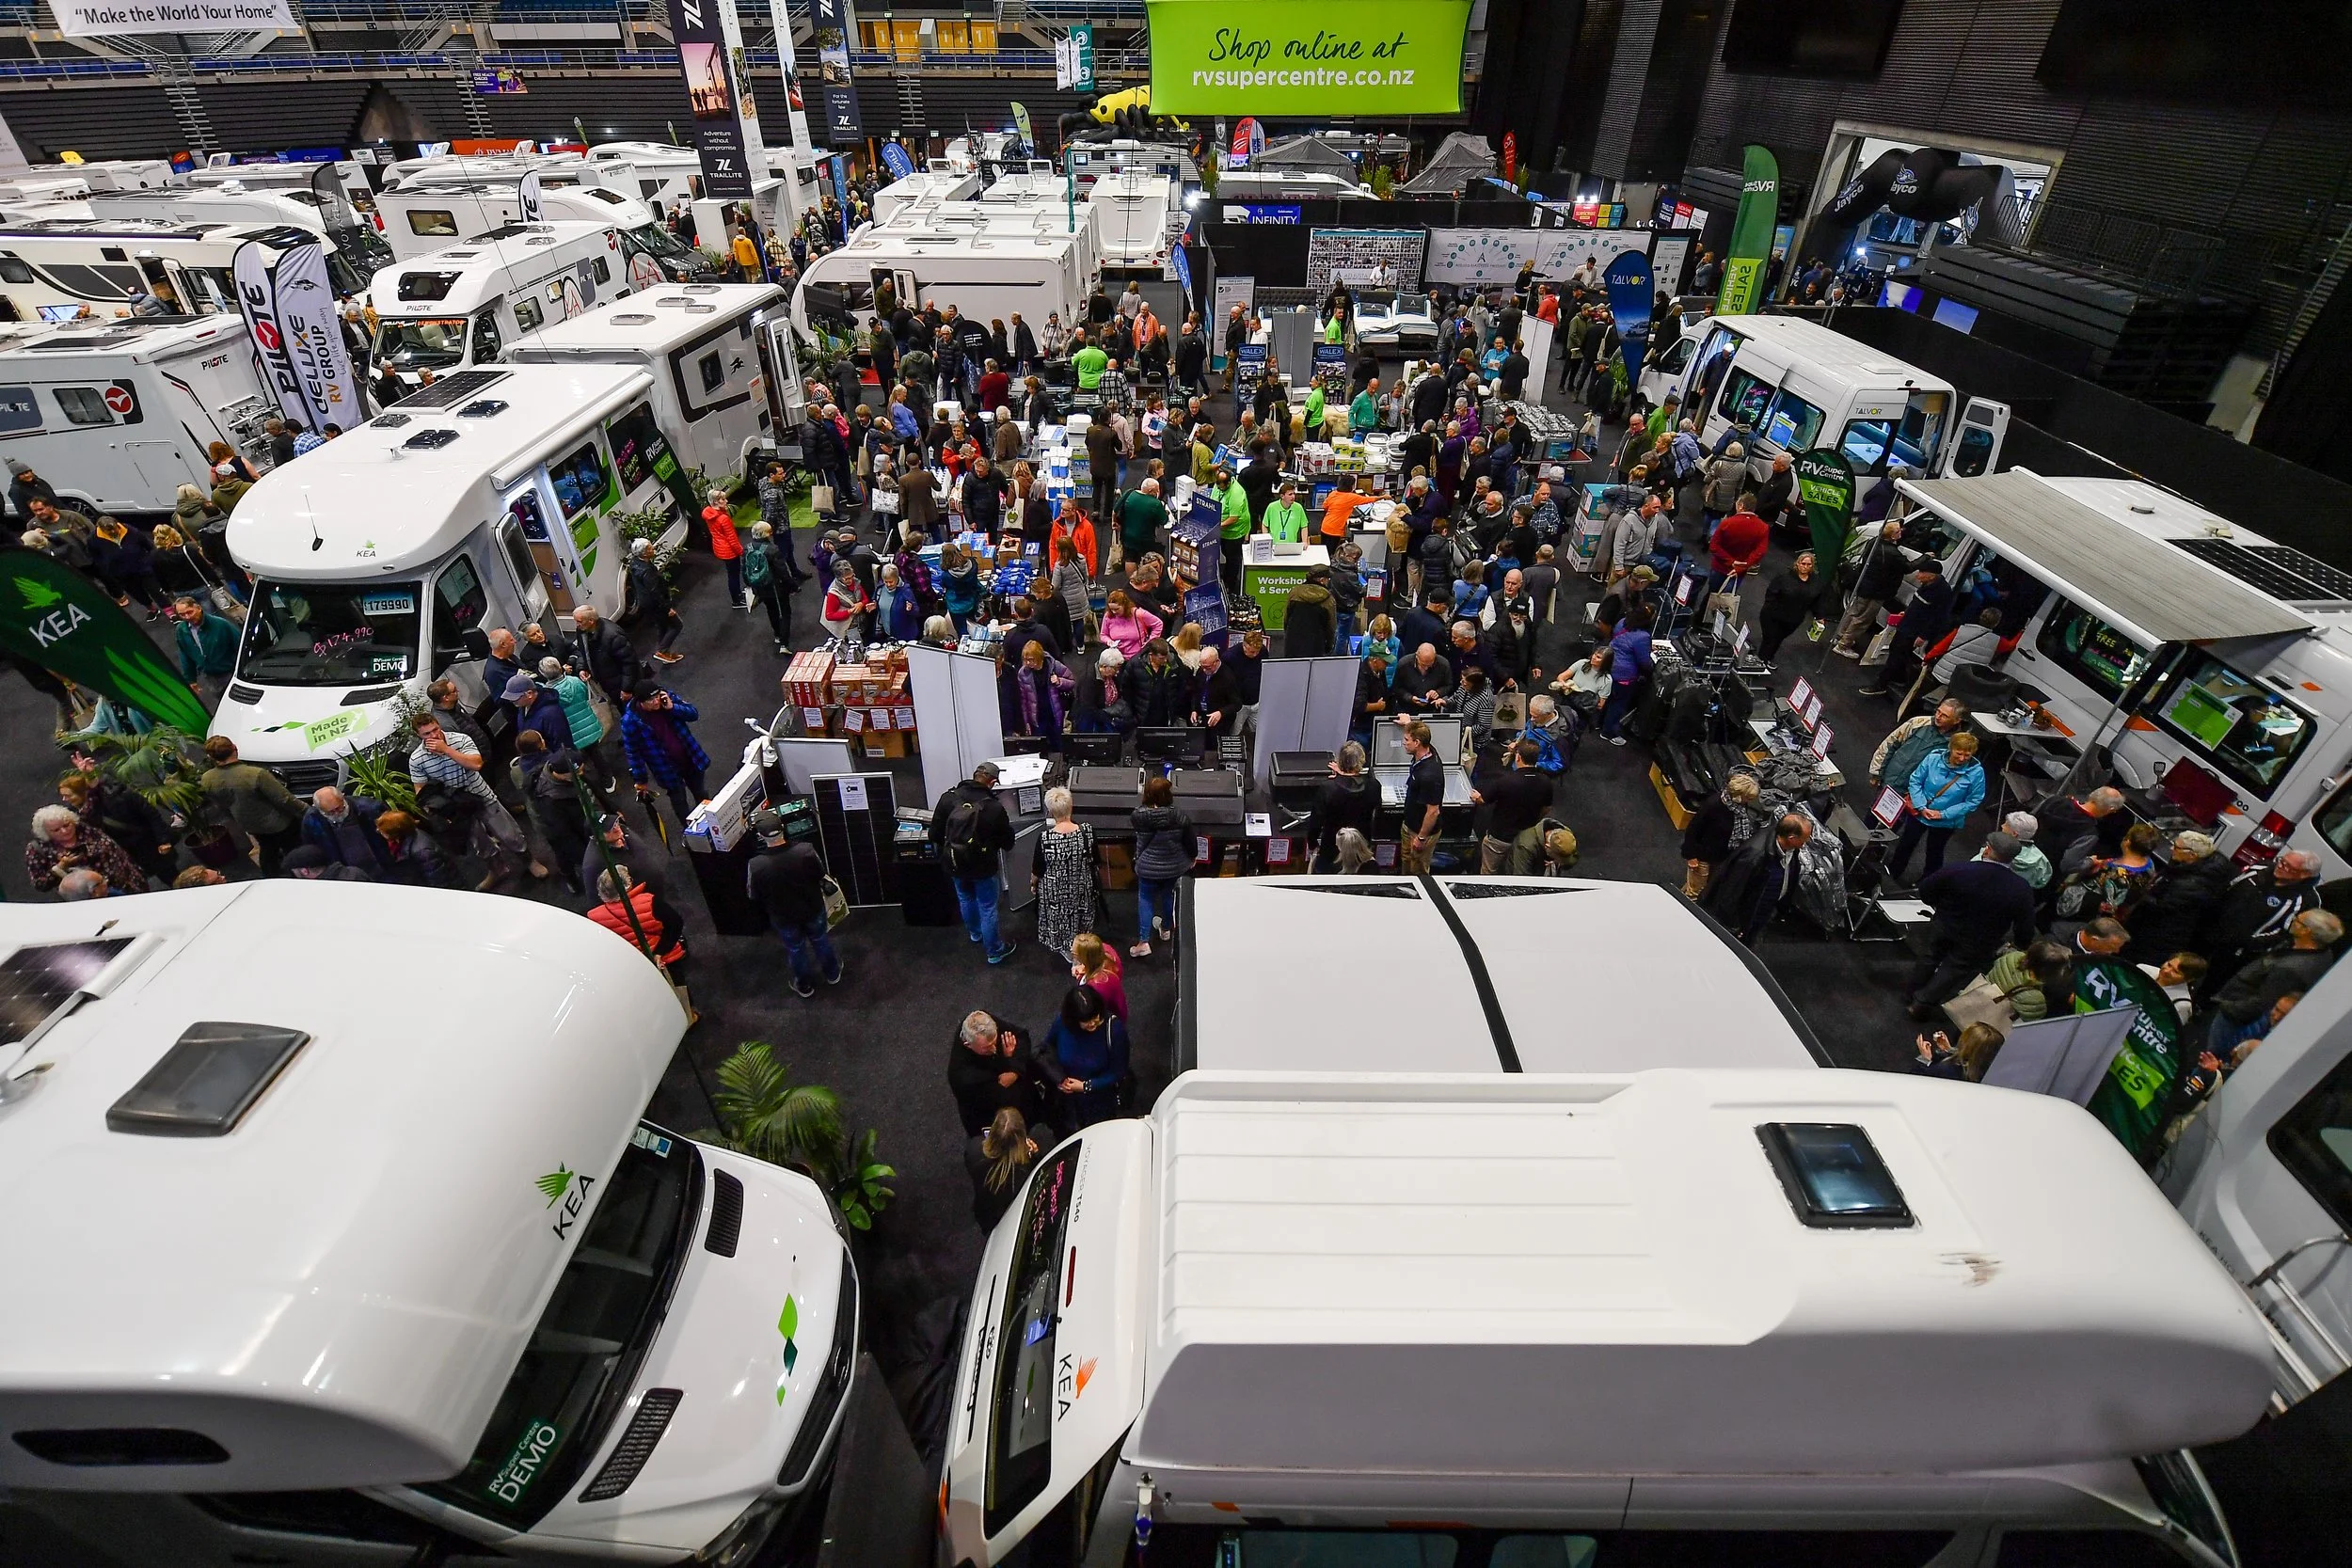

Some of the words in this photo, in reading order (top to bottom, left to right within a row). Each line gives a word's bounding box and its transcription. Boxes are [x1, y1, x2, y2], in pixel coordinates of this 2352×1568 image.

[130, 7, 155, 22] the
[156, 5, 200, 21] World
[203, 5, 231, 19] Your
[1209, 28, 1271, 68] Shop
[1283, 30, 1365, 60] online
[1371, 31, 1410, 59] at
[1192, 68, 1415, 89] rvsupercentre.co.nz
[1835, 182, 1864, 213] Jayco
[1252, 216, 1297, 225] INFINITY
[1612, 275, 1645, 286] TALVOR
[311, 325, 336, 379] GROUP
[326, 382, 343, 404] RV
[1855, 407, 1883, 416] TALVOR
[1800, 461, 1824, 476] RV
[1823, 465, 1846, 476] Super
[1820, 470, 1844, 482] Centre
[1807, 491, 1839, 504] SALES
[1810, 484, 1842, 497] VEHICLE
[1196, 497, 1217, 512] STRAHL
[1202, 539, 1217, 548] STRAHL
[28, 603, 92, 648] KEA
[310, 716, 347, 735] Made
[313, 735, 326, 743] in
[329, 724, 350, 737] NZ
[2084, 967, 2133, 1009] RV
[2136, 1006, 2171, 1044] uper
[2132, 1022, 2168, 1054] ntre
[552, 1175, 596, 1241] KEA
[1057, 1354, 1073, 1422] KEA
[518, 1421, 540, 1450] Centre
[498, 1426, 556, 1503] DEMO
